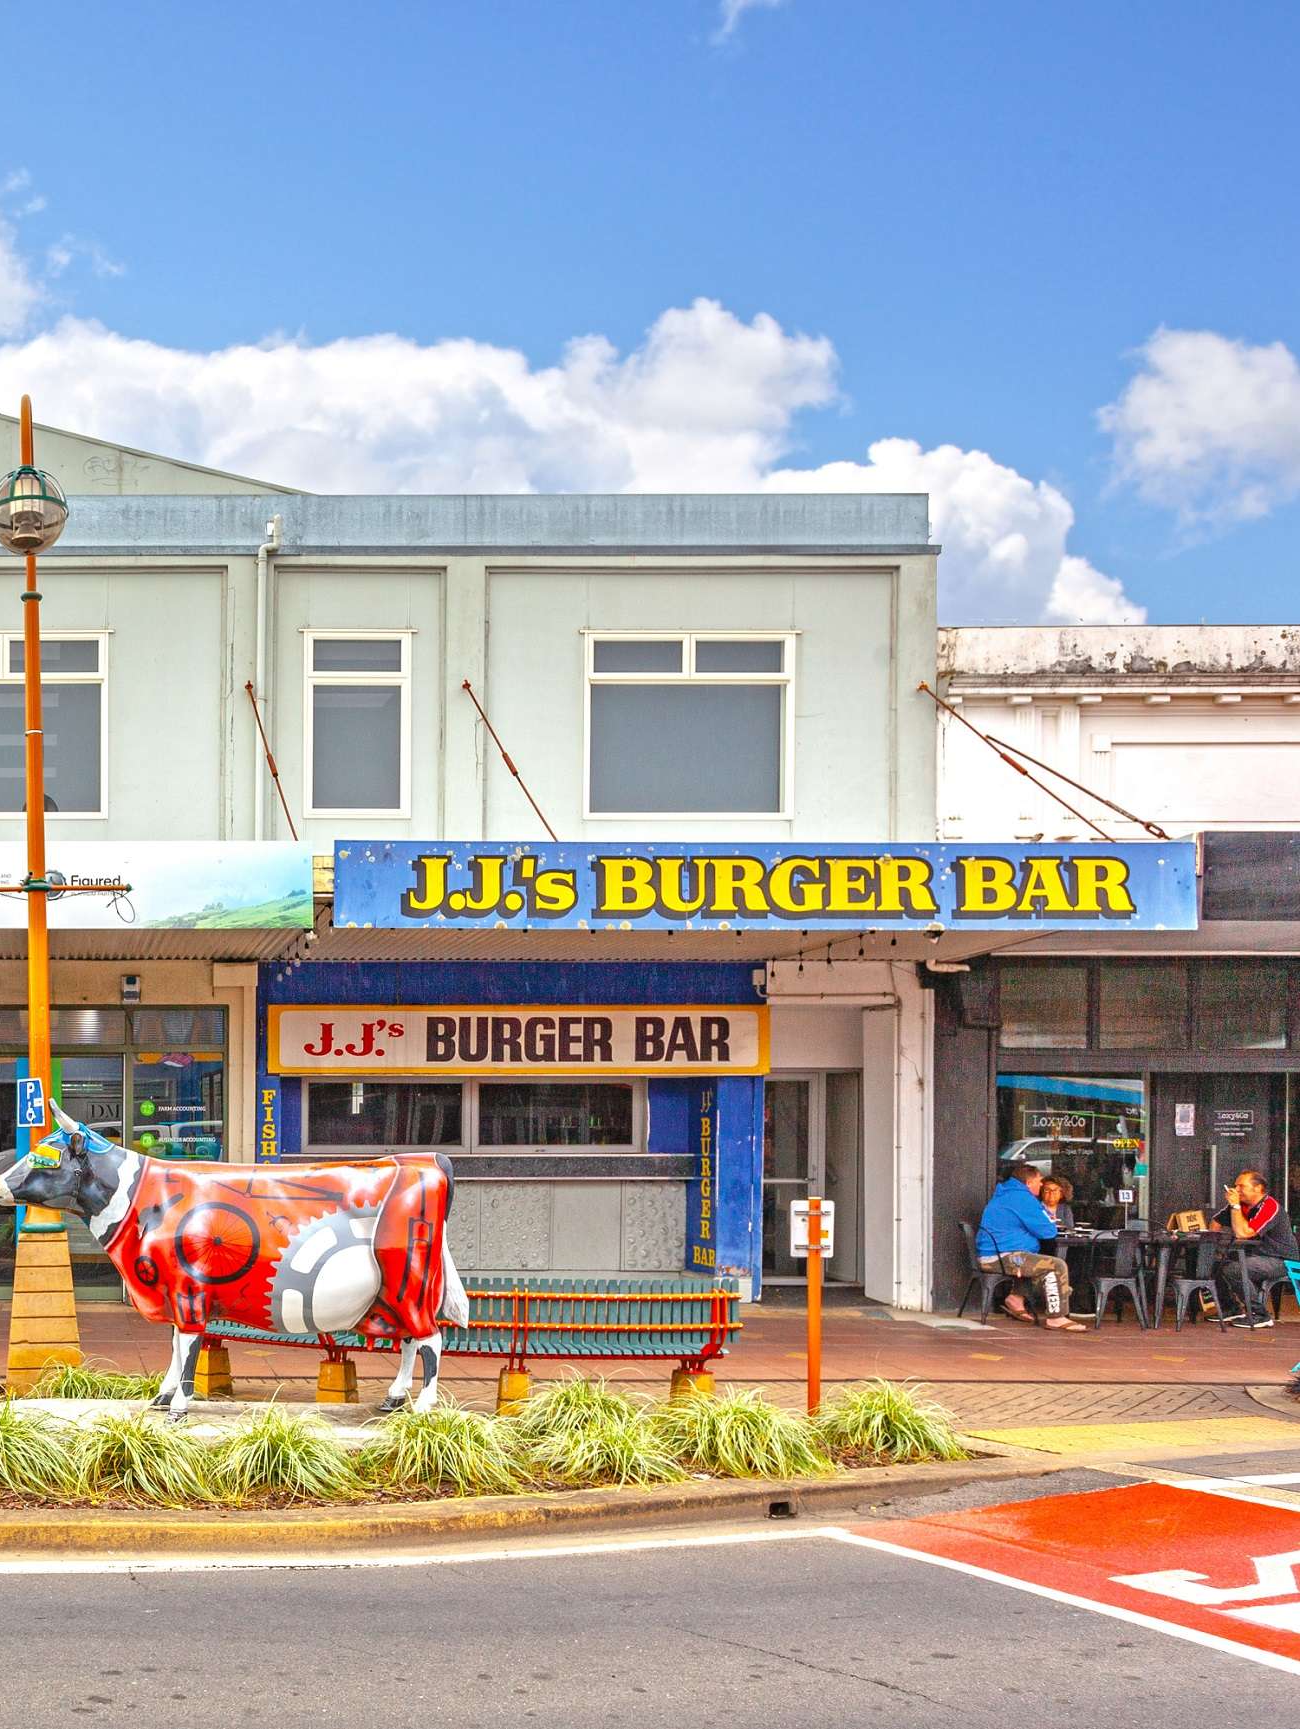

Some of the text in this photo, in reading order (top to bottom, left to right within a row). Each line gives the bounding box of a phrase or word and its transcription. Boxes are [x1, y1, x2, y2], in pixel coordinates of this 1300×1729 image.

[71, 875, 121, 888] Figured
[403, 856, 1137, 917] J.J.'s BURGER BAR
[304, 1017, 731, 1062] J.J.'s BURGER BAR
[27, 1082, 35, 1100] P
[262, 1090, 277, 1156] FISH
[1032, 1115, 1086, 1131] Loxy&Co
[1113, 1138, 1141, 1149] OPEN
[701, 1117, 711, 1240] BURGER
[693, 1245, 716, 1268] BAR
